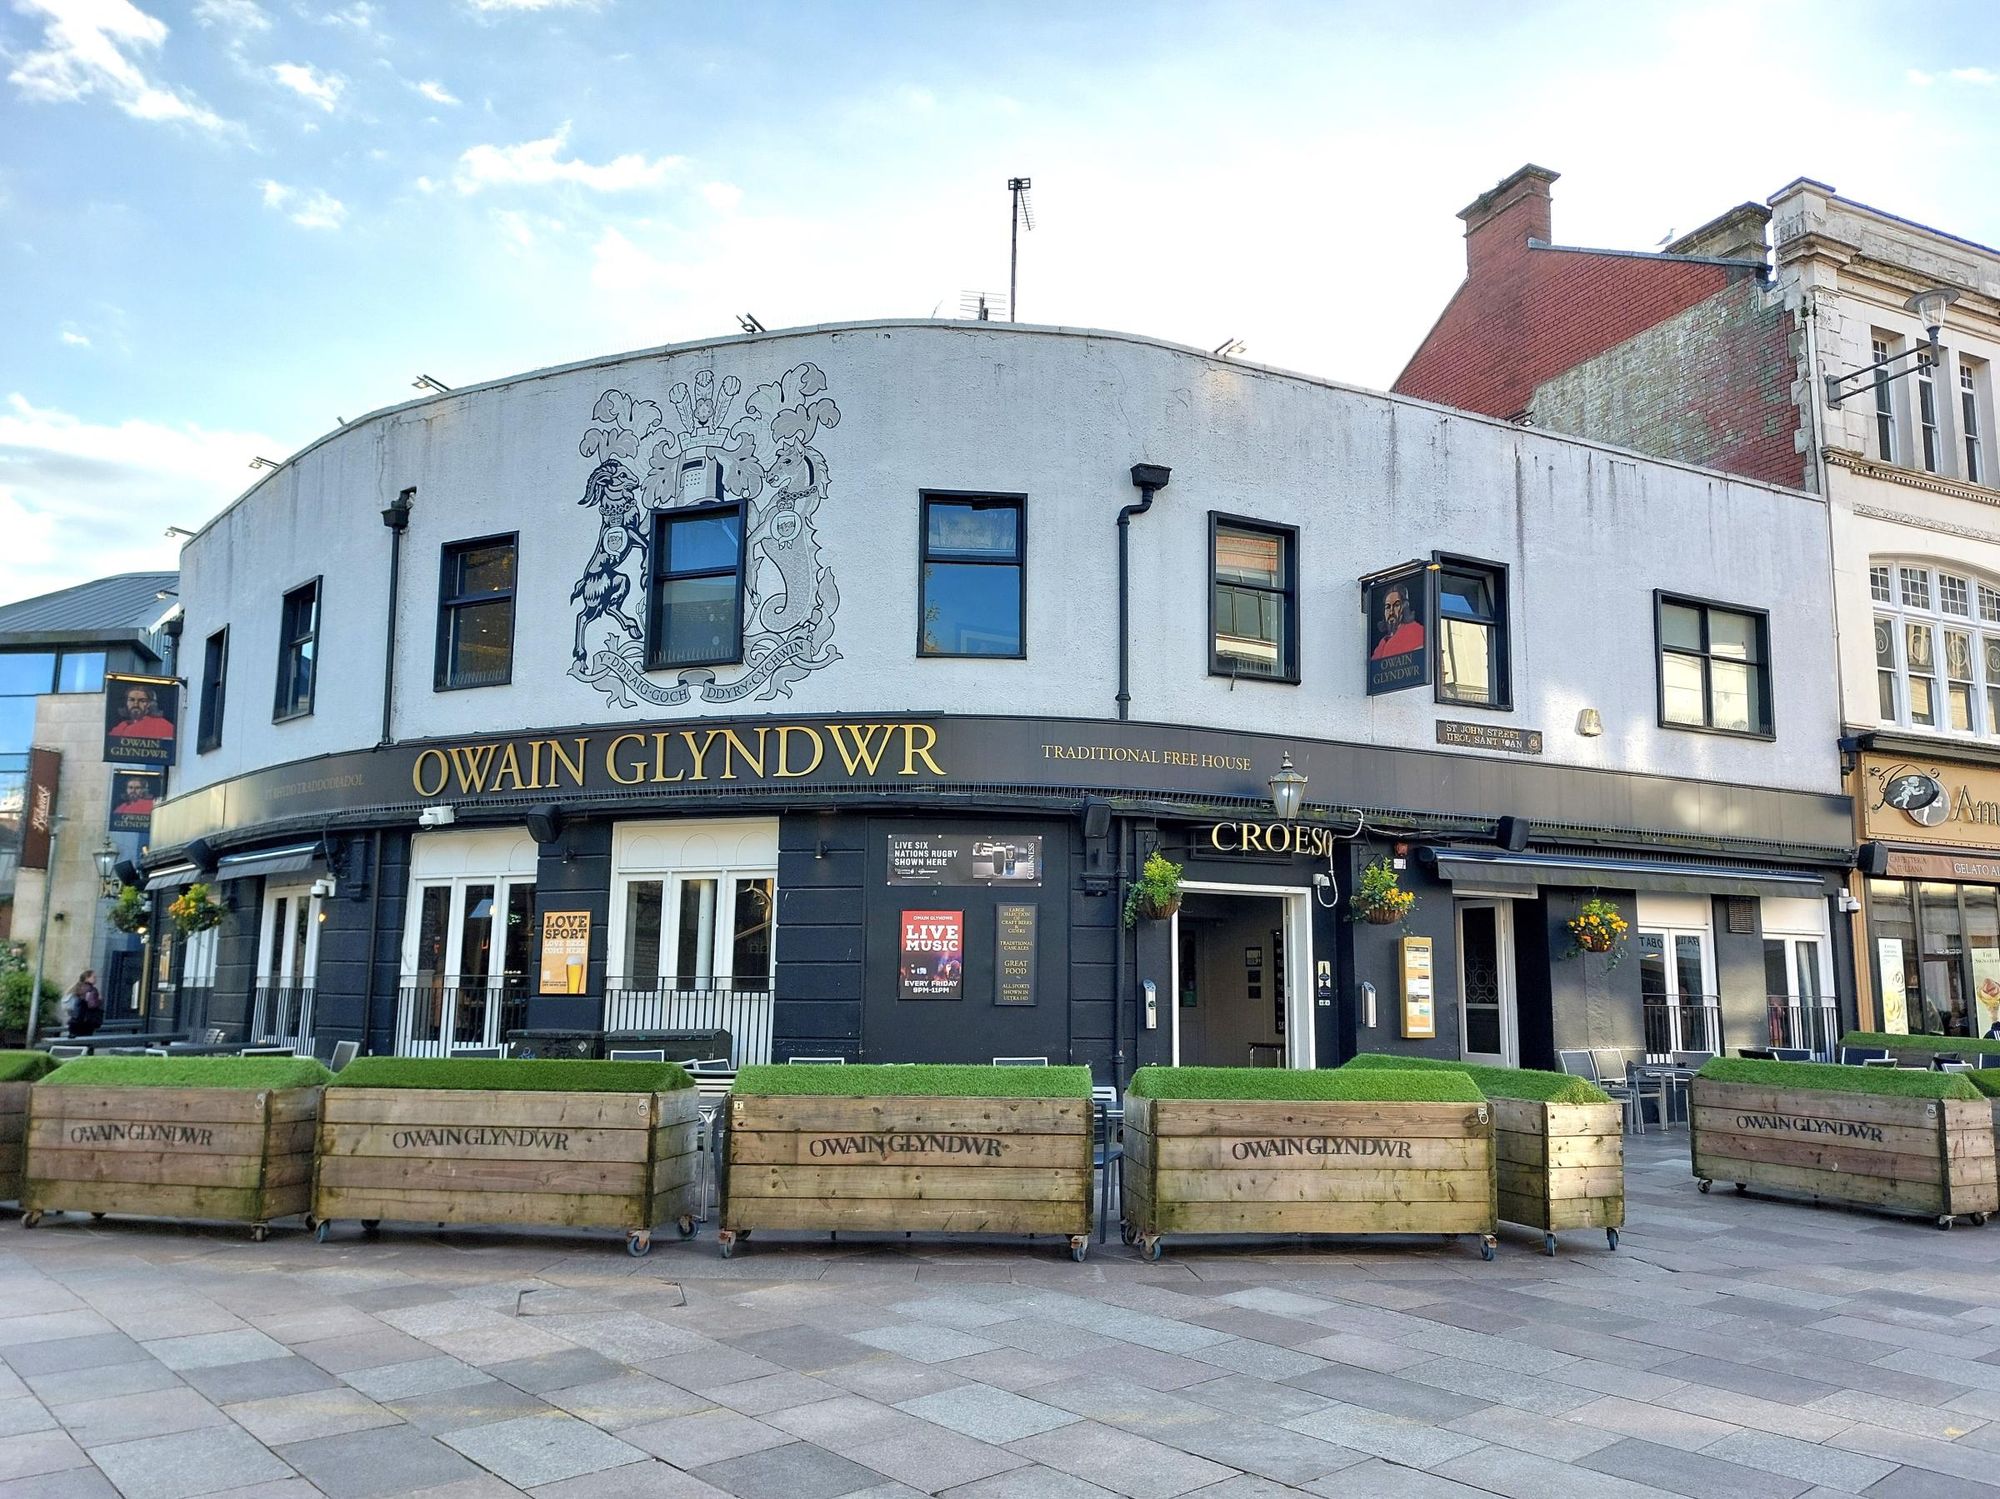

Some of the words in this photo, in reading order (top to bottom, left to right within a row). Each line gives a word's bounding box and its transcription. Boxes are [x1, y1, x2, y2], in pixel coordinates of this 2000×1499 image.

[1380, 654, 1413, 671] OWAIN
[1372, 664, 1421, 686] GLYNDWR
[651, 688, 689, 702] GOCH
[706, 682, 749, 700] DDYRY
[1446, 723, 1457, 733] ST
[1460, 724, 1484, 736] JOHN
[1487, 728, 1520, 740] STREET
[120, 737, 160, 748] OWAIN
[1474, 736, 1498, 746] SANT
[110, 747, 168, 759] GLYNDWR
[412, 738, 590, 798] OWAIN
[605, 723, 947, 786] GLYNDWR
[1041, 744, 1160, 764] TRADITIONAL
[1163, 751, 1199, 767] FREE
[1201, 754, 1252, 771] HOUSE
[894, 841, 913, 849] LIVE
[914, 841, 929, 849] SIX
[1211, 822, 1332, 858] CROESO
[894, 850, 930, 858] NATIONS
[931, 850, 958, 858] RUGBY
[894, 858, 925, 866] SHOWN
[926, 858, 948, 866] HERE
[1953, 862, 1990, 875] GELATO
[545, 915, 588, 928] LOVE
[545, 928, 588, 939] SPORT
[906, 925, 959, 940] LIVE
[906, 940, 959, 951] MUSIC
[71, 1123, 126, 1144] OWAIN
[128, 1122, 214, 1147] GLYNDWR
[1736, 1114, 1791, 1132] OWAIN
[1793, 1117, 1884, 1143] GLYNDWR
[392, 1128, 463, 1149] OWAIN
[465, 1128, 570, 1150] GLYNDWR
[809, 1135, 886, 1158] OWAIN
[888, 1134, 1003, 1158] GLYNDWR
[1231, 1138, 1305, 1160] OWAIN
[1305, 1136, 1413, 1159] GLYNDWR
